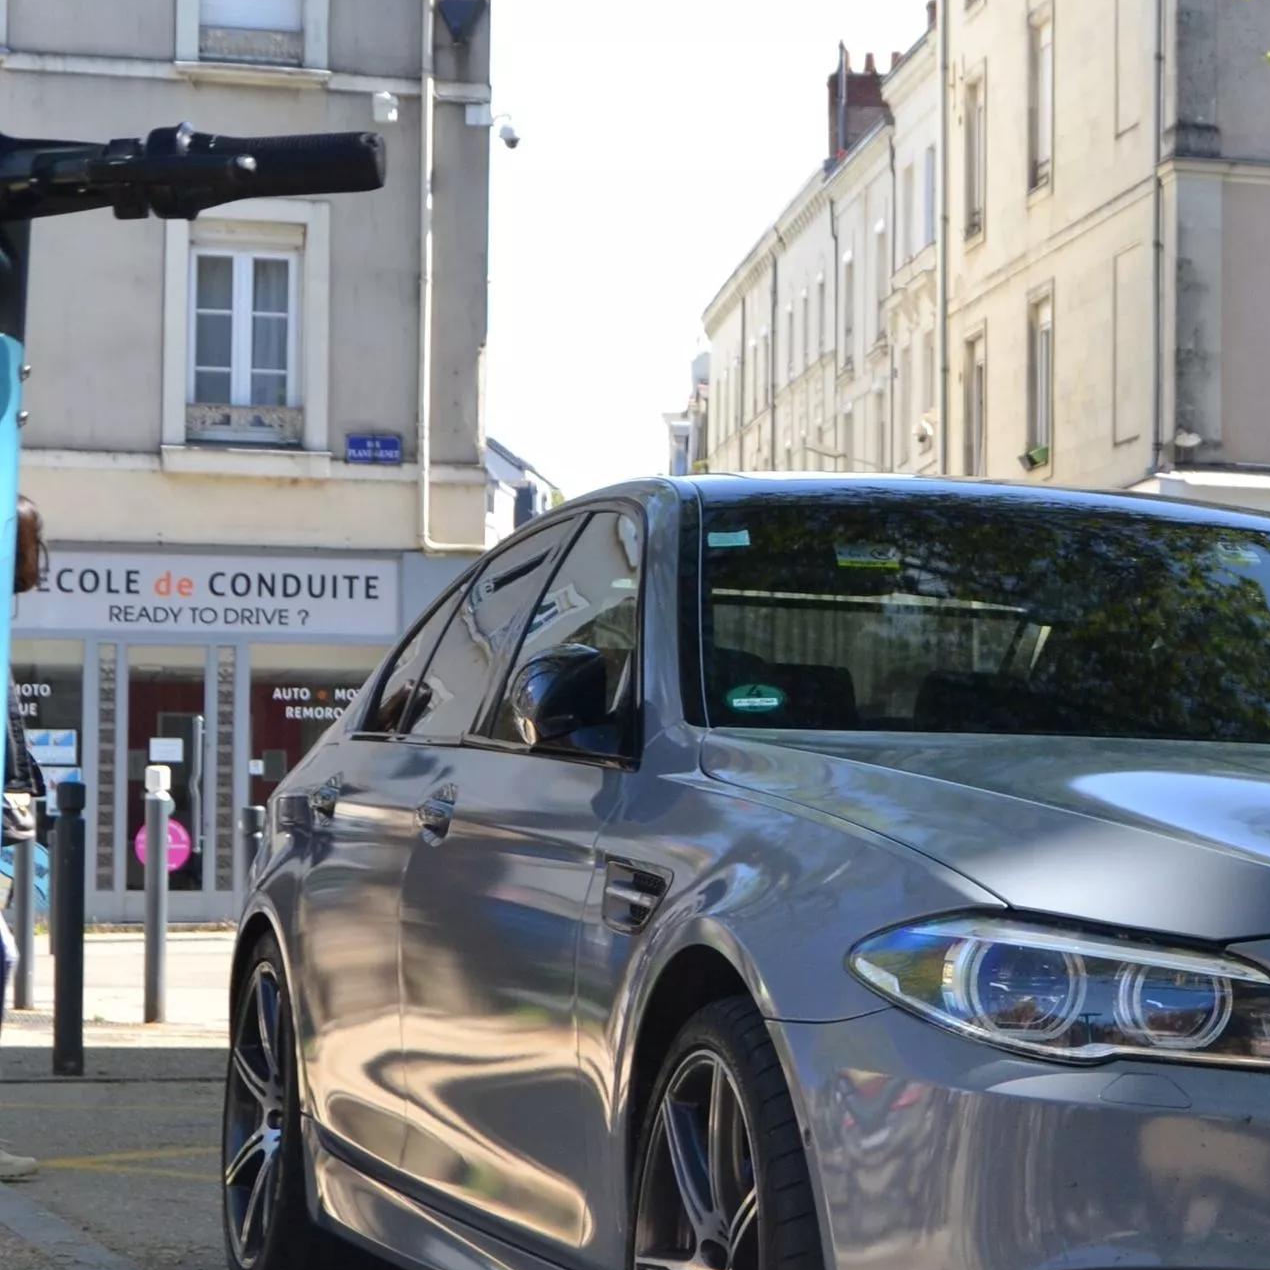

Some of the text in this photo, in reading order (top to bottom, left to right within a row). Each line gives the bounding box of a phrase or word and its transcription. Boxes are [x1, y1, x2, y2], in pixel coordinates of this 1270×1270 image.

[155, 571, 194, 597] de
[208, 572, 380, 600] CONDUITE
[109, 606, 310, 627] READY TO DRIVE ?
[272, 687, 312, 701] AUTO
